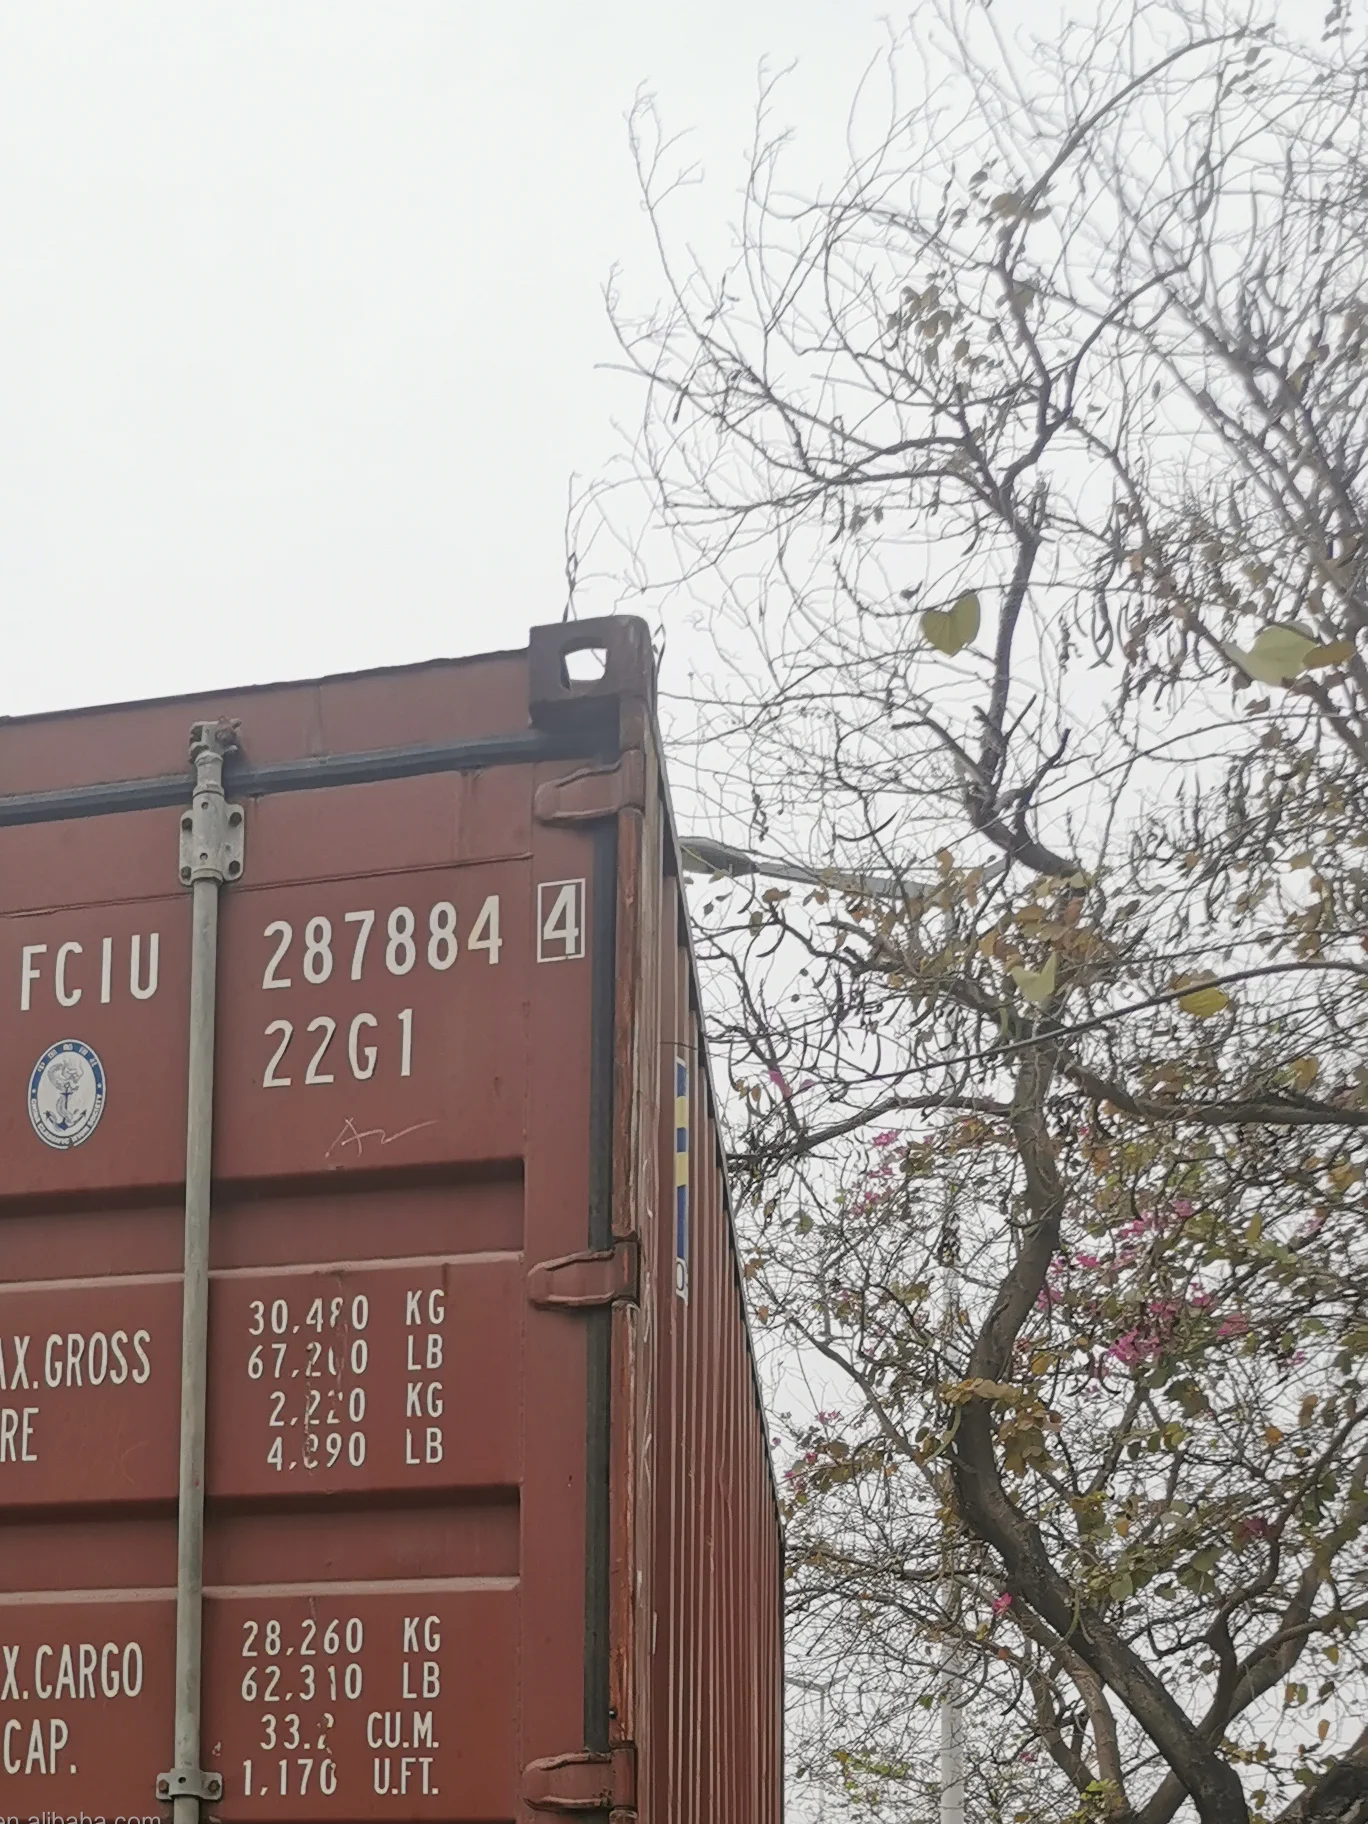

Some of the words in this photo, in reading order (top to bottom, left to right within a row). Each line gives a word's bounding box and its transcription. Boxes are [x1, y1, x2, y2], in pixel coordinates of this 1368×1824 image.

[20, 932, 160, 1011] FCIU
[261, 894, 503, 990] 287884
[542, 883, 580, 955] 4
[262, 1008, 413, 1088] 22G1
[405, 1288, 445, 1326] KG
[407, 1333, 443, 1371] LB
[406, 1381, 443, 1418] KG
[405, 1427, 443, 1465] LB
[241, 1617, 363, 1658] 28,260
[403, 1615, 441, 1653] KG
[241, 1663, 363, 1702] 62,310
[402, 1661, 441, 1699] LB
